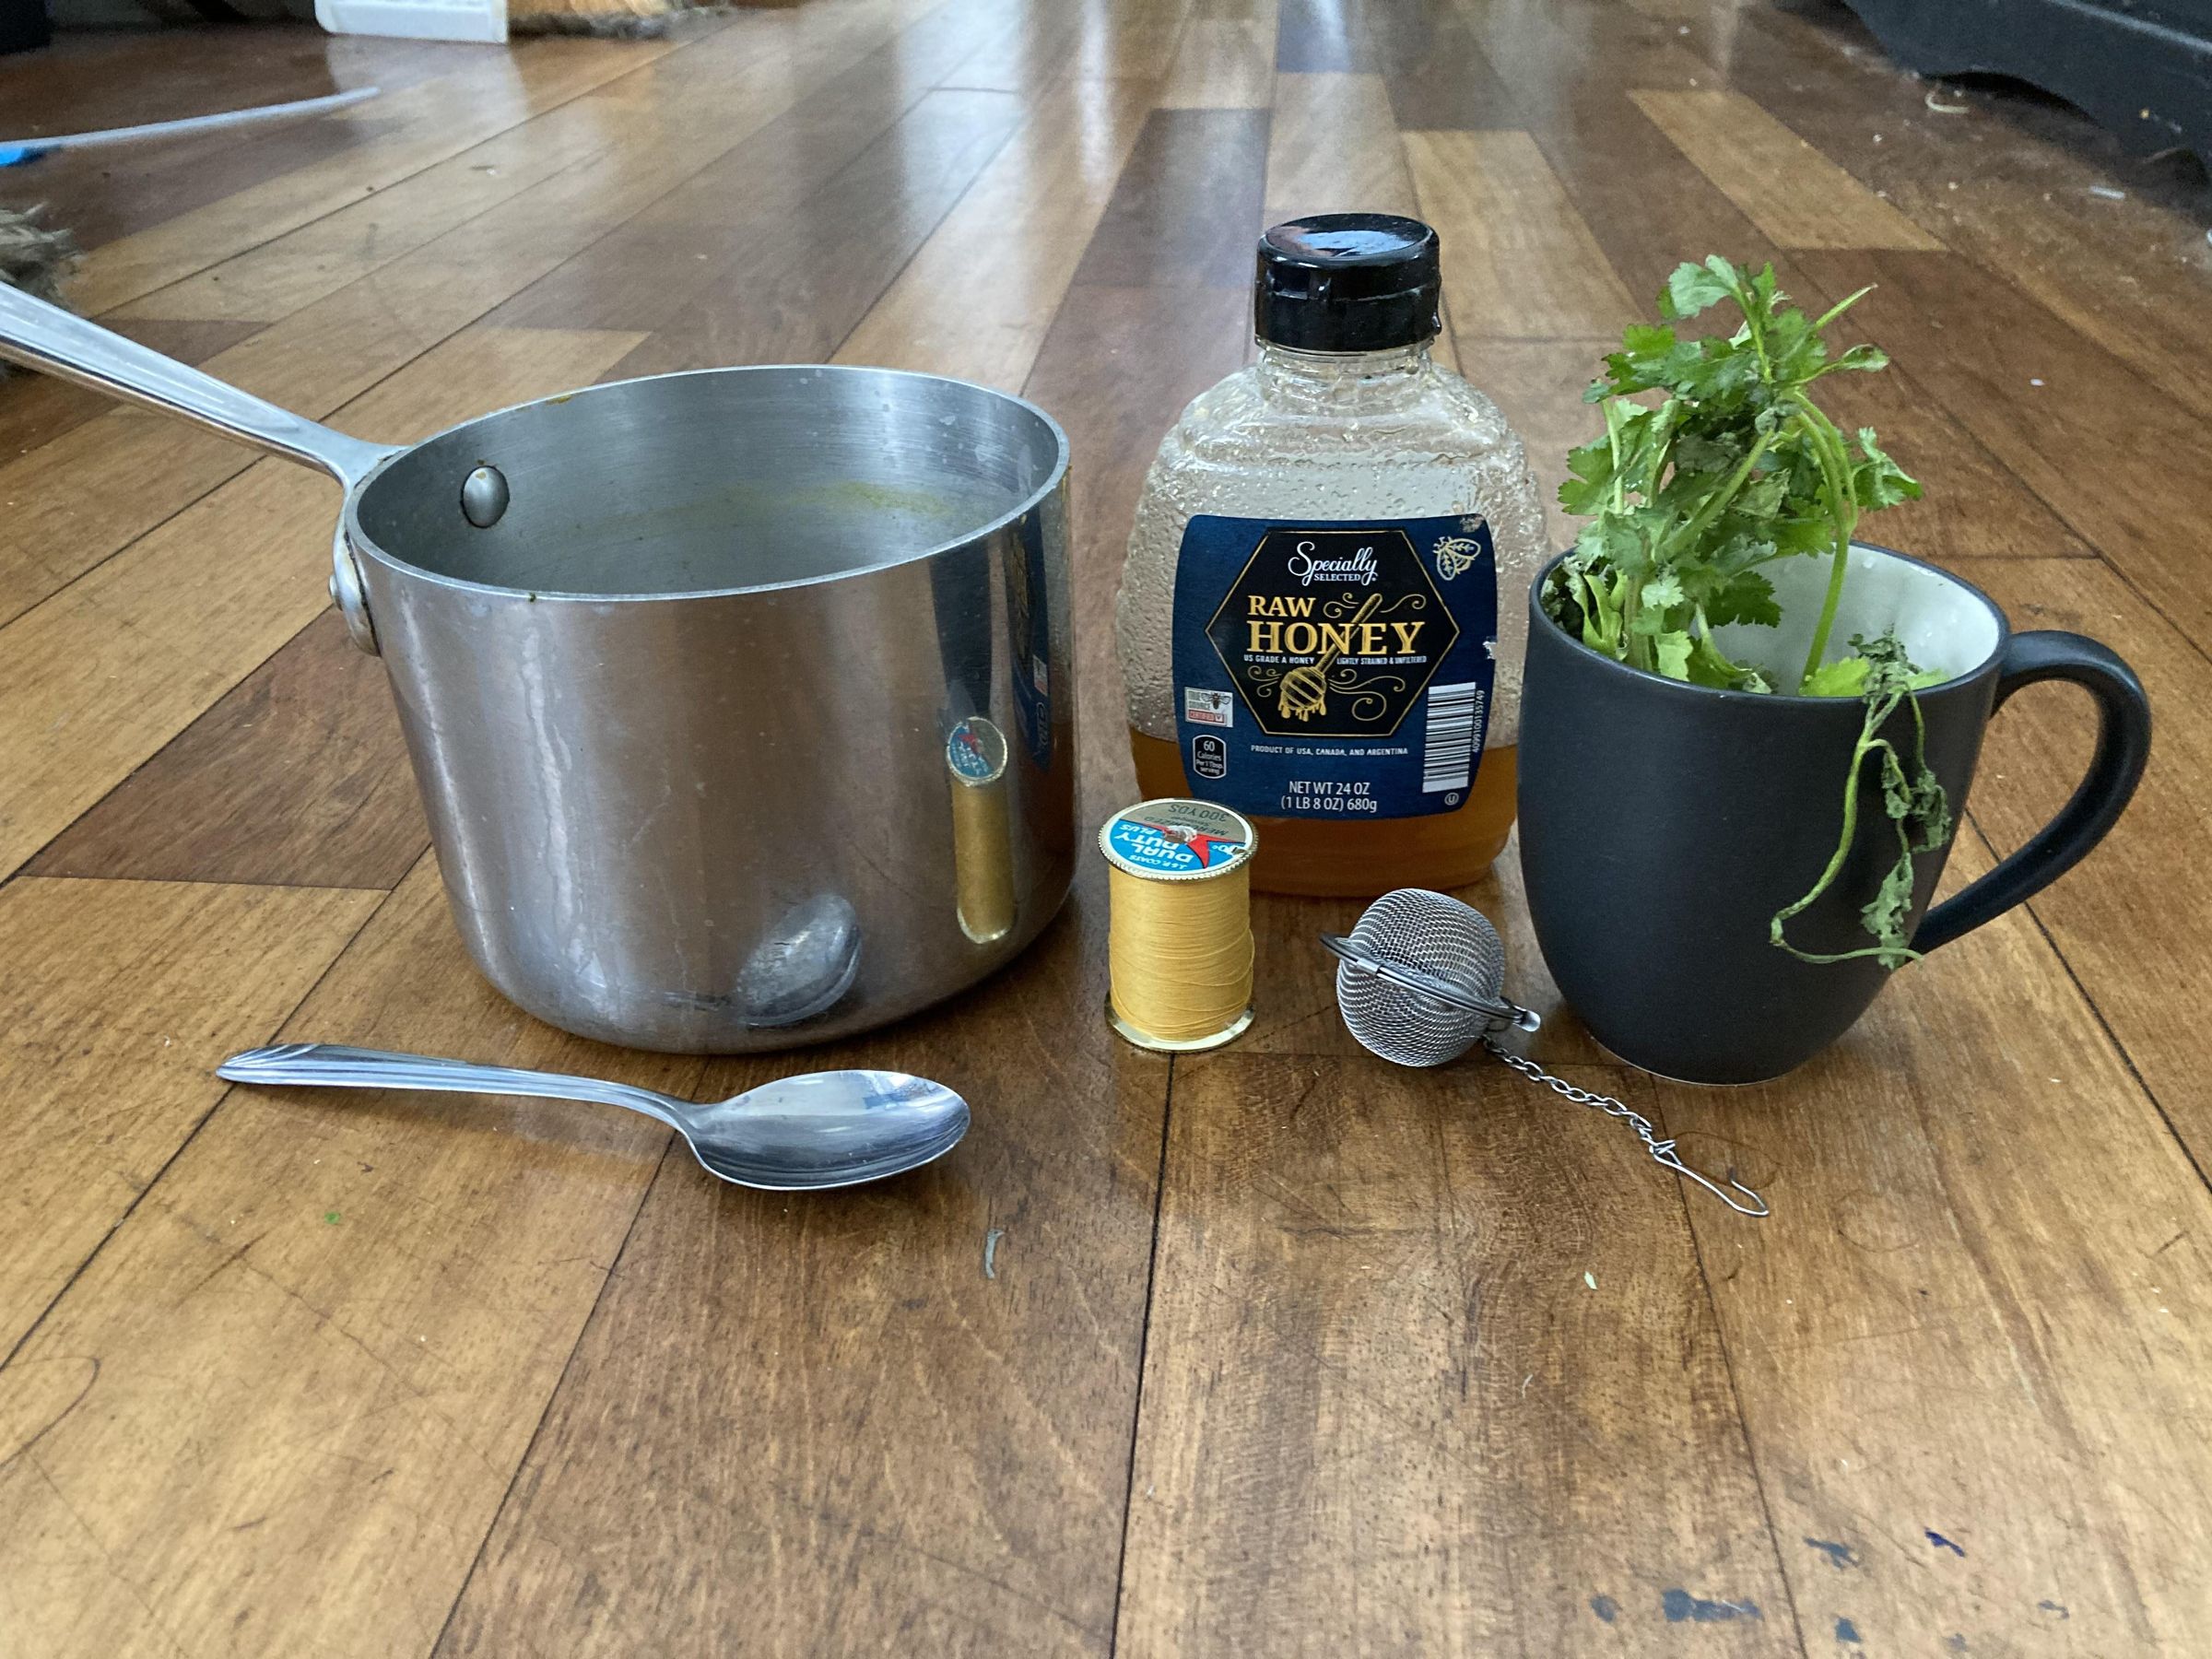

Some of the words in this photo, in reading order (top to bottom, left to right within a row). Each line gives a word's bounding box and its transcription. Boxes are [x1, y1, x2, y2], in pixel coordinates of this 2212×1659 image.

[1288, 541, 1379, 586] Specially
[1313, 573, 1361, 582] SELECTED
[1247, 594, 1317, 618] RAW
[1246, 619, 1426, 655] HONEY
[1243, 654, 1253, 663] US
[1255, 655, 1280, 664] GRADE
[1288, 656, 1315, 665] HONEY
[1389, 656, 1394, 665] &
[1203, 740, 1216, 752] 60
[1251, 745, 1283, 754] PRODUCT
[1297, 747, 1314, 756] USA,
[1315, 747, 1347, 757] CANADA,
[1366, 747, 1408, 756] ARGENTINA
[1288, 781, 1312, 794] NET
[1312, 782, 1334, 795] WT
[1335, 782, 1351, 795] 24
[1354, 782, 1371, 795] OZ
[1168, 804, 1199, 817] YDS
[1280, 795, 1291, 810] (1
[1296, 796, 1311, 809] LB
[1312, 797, 1322, 810] 8
[1323, 797, 1345, 812] OZ)
[1347, 798, 1377, 813] 680g
[1200, 809, 1230, 823] 300
[1120, 824, 1159, 835] PLUS
[1113, 831, 1180, 851] DUTY
[1128, 853, 1162, 865] COATS
[1130, 842, 1194, 864] DUAL
